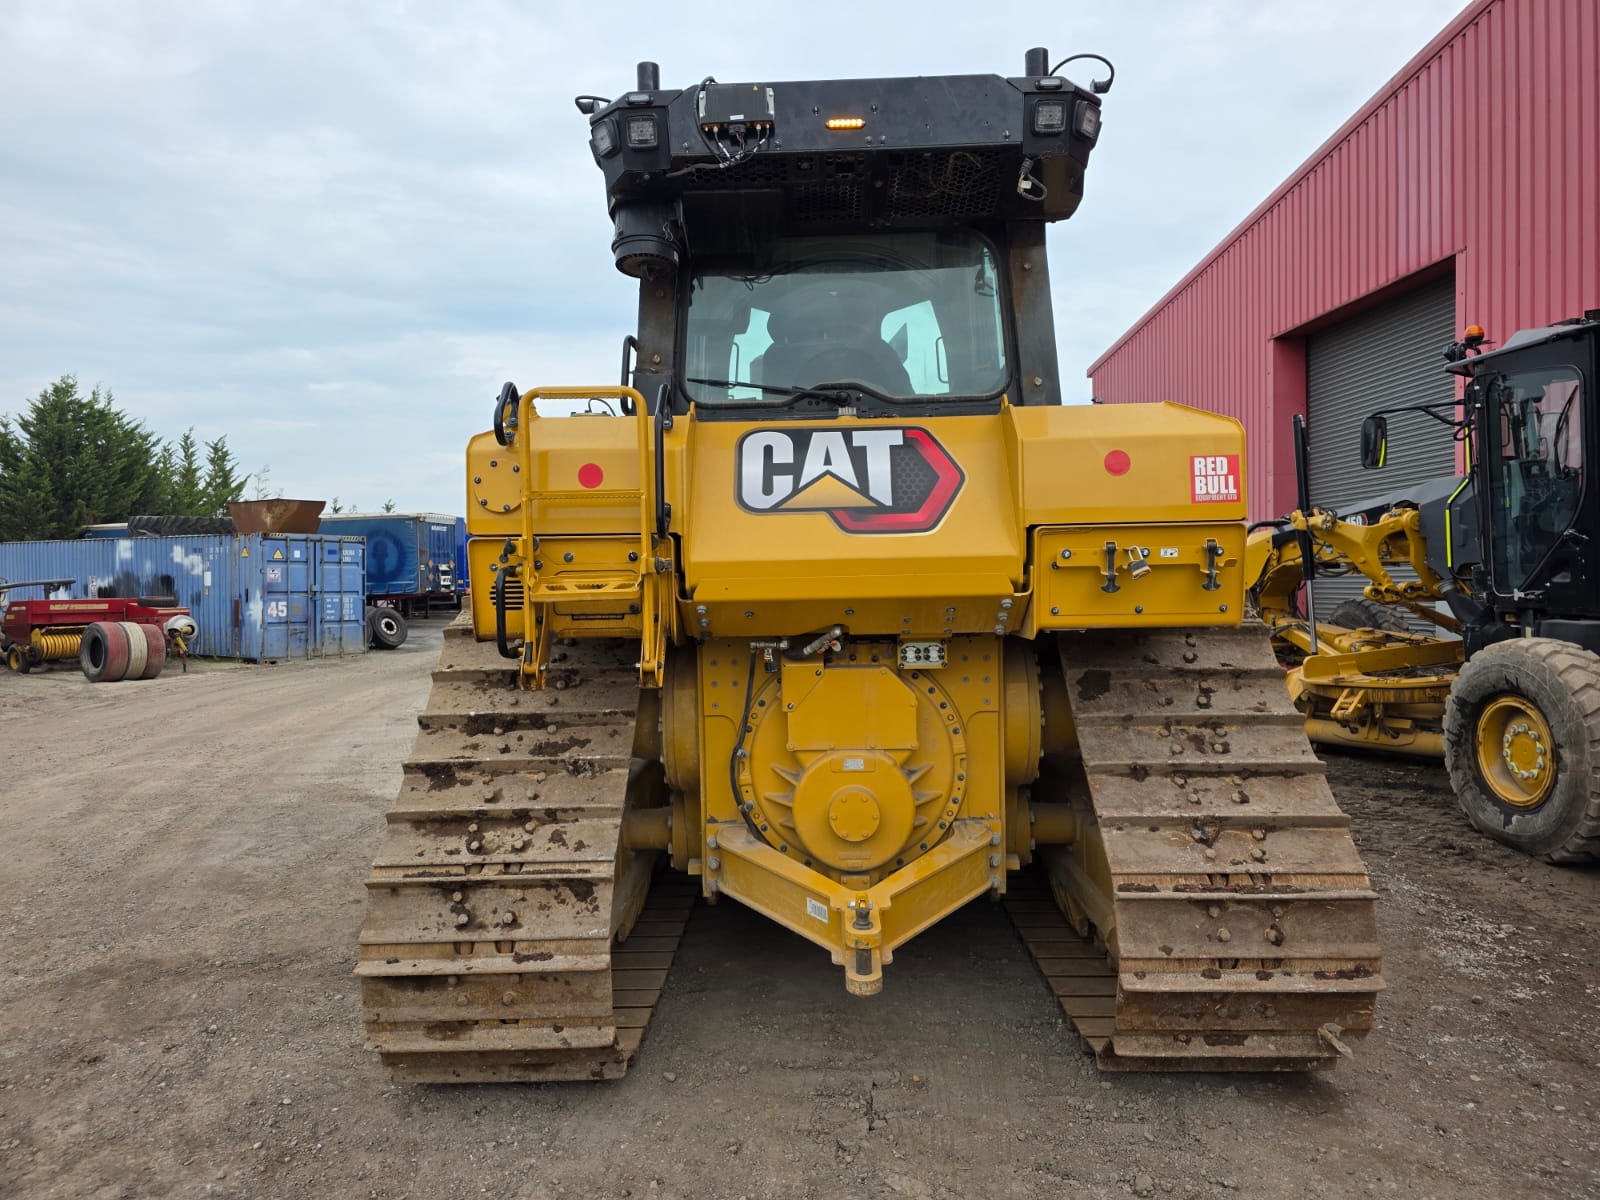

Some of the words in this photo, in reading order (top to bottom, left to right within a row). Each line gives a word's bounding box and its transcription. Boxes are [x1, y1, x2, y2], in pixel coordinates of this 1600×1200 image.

[742, 429, 904, 509] CAT
[1194, 456, 1228, 476] RED
[1195, 475, 1237, 494] BULL
[267, 601, 288, 617] 45
